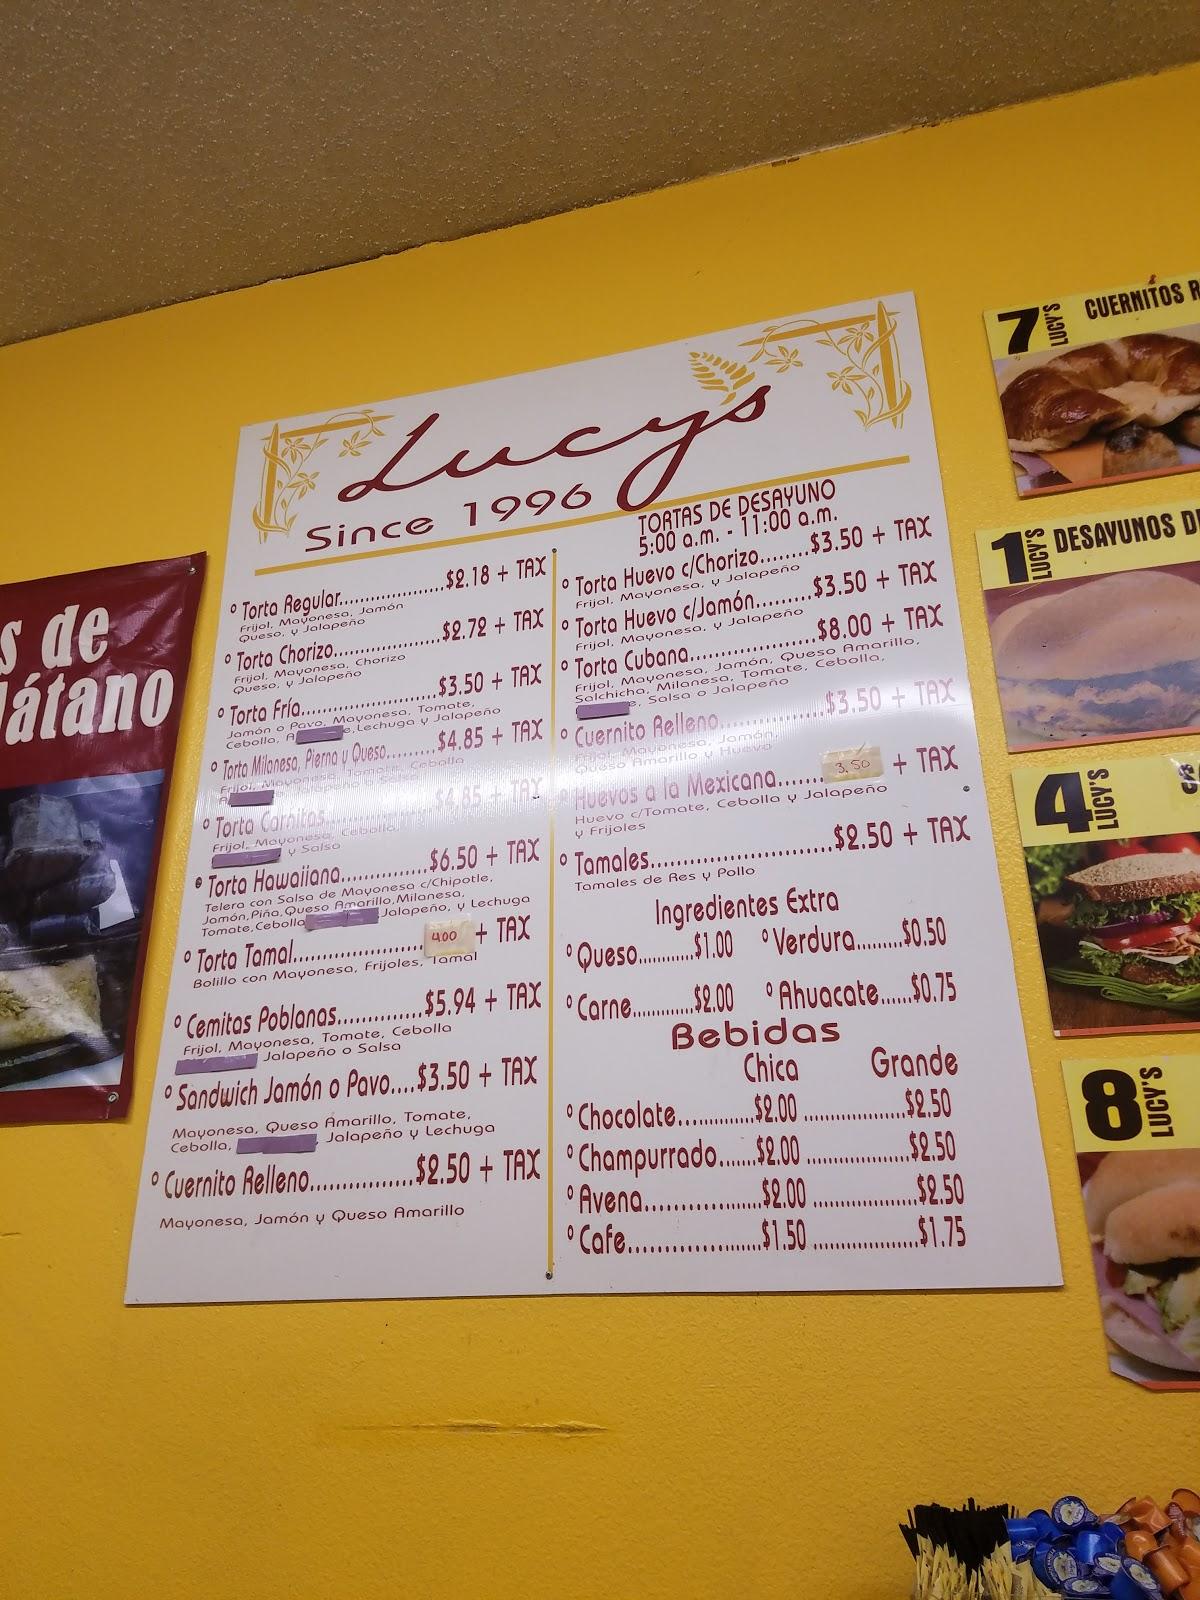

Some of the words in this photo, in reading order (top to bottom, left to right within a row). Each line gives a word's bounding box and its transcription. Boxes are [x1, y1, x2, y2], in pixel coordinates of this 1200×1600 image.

[1084, 282, 1185, 320] CUERNITOS
[997, 306, 1040, 355] 7
[1042, 303, 1069, 347] LUCY'S
[305, 516, 434, 553] Since
[463, 483, 592, 527] 1996
[638, 504, 703, 535] TORTAS
[710, 498, 732, 522] DE
[738, 478, 836, 517] DESAYUNO
[639, 530, 676, 557] 5:00
[682, 528, 719, 548] a.m.
[741, 508, 791, 537] 11:00
[798, 507, 838, 526] a.m.
[1053, 513, 1177, 554] DESAYUNOS
[576, 575, 617, 597] Torta
[624, 565, 675, 588] Huevo
[810, 525, 863, 554] $3.50
[893, 515, 932, 541] TAX
[726, 564, 800, 582] Jalapeño
[990, 531, 1029, 585] 1
[1024, 527, 1053, 581] LUCY'S
[242, 600, 278, 621] Torta
[446, 564, 490, 590] $2.18
[516, 555, 547, 579] TAX
[359, 602, 404, 614] Jamón
[576, 616, 618, 638] Torta
[624, 607, 676, 631] Huevo
[813, 569, 867, 598] $3.50
[898, 560, 937, 586] TAX
[41, 604, 110, 670] de
[304, 618, 365, 633] Jalapeño
[728, 608, 804, 626] Jalapeño
[237, 651, 273, 672] Torta
[442, 616, 487, 642] $2.72
[513, 608, 544, 632] TAX
[355, 654, 406, 666] Chorizo
[575, 656, 618, 679] Torta
[817, 612, 872, 641] $8.00
[903, 603, 944, 630] TAX
[781, 648, 836, 661] Queso
[230, 705, 267, 727] Torta
[438, 671, 484, 698] $3.50
[511, 663, 542, 688] TAX
[298, 670, 362, 686] Jalapeño
[649, 692, 691, 705] Salsa
[713, 677, 789, 695] Jalapeño
[226, 726, 271, 740] Jamón
[433, 707, 501, 722] Jalapeño
[575, 721, 646, 748] Cuernito
[825, 686, 881, 715] $3.50
[914, 678, 956, 706] TAX
[223, 760, 248, 780] Torta
[305, 748, 337, 770] Pierna
[438, 726, 483, 752] $4.85
[511, 718, 543, 743] TAX
[575, 786, 638, 810] Huevos
[664, 776, 680, 800] la
[916, 745, 958, 773] TAX
[575, 812, 624, 825] Huevo
[717, 792, 780, 808] Cebolla
[804, 784, 888, 800] Jalapeño
[1034, 772, 1094, 834] 4
[1087, 768, 1120, 830] LUCY'S
[216, 815, 254, 839] Torta
[590, 823, 646, 836] Frijoles
[834, 821, 893, 851] $2.50
[927, 815, 971, 844] TAX
[208, 874, 247, 898] Torta
[430, 844, 478, 872] $6.50
[506, 838, 540, 865] TAX
[301, 842, 341, 854] Salsa
[575, 878, 637, 891] Tamales
[643, 875, 663, 885] de
[668, 872, 696, 883] Res
[717, 866, 756, 878] Pollo
[206, 902, 245, 913] Telera
[250, 899, 272, 907] con
[277, 894, 314, 905] Salsa
[319, 890, 336, 900] de
[285, 904, 329, 916] Queso
[471, 896, 530, 908] Lechuga
[655, 893, 779, 931] Ingredientes
[786, 887, 839, 914] Extra
[197, 948, 237, 974] Torta
[497, 914, 531, 943] TAX
[694, 929, 733, 960] $1.00
[902, 916, 947, 948] $0.50
[193, 976, 236, 989] Bolillo
[242, 974, 267, 983] con
[694, 982, 734, 1014] $2.00
[911, 971, 957, 1004] $0.75
[186, 1011, 252, 1039] Cemitas
[425, 987, 476, 1017] $5.94
[506, 981, 542, 1010] TAX
[392, 1023, 452, 1036] Cebolla
[263, 1047, 336, 1062] Jalapeño
[358, 1041, 401, 1054] Salsa
[671, 1017, 841, 1050] Bebidas
[176, 1077, 258, 1111] Sandwich
[263, 1073, 322, 1104] Jamón
[329, 1078, 340, 1099] o
[417, 1060, 470, 1092] $3.50
[501, 1056, 537, 1086] TAX
[744, 1052, 799, 1083] Chica
[871, 1044, 959, 1078] Grande
[754, 1092, 797, 1124] $2.00
[905, 1087, 952, 1119] $2.50
[1081, 1069, 1144, 1142] 8
[1139, 1066, 1175, 1138] LUCY'S
[266, 1121, 319, 1134] Queso
[326, 1129, 403, 1143] Jalapeño
[426, 1124, 495, 1136] Lechuga
[756, 1134, 800, 1166] $2.00
[909, 1130, 956, 1162] $2.50
[164, 1169, 236, 1199] Cuernito
[416, 1152, 470, 1185] $2.50
[503, 1149, 541, 1181] TAX
[762, 1177, 806, 1209] $2.00
[917, 1173, 964, 1206] $2.50
[255, 1212, 309, 1225] Jamón
[332, 1209, 387, 1223] Queso
[394, 1204, 465, 1218] Amarillo
[762, 1218, 806, 1251] $1.50
[918, 1214, 967, 1248] $1.75
